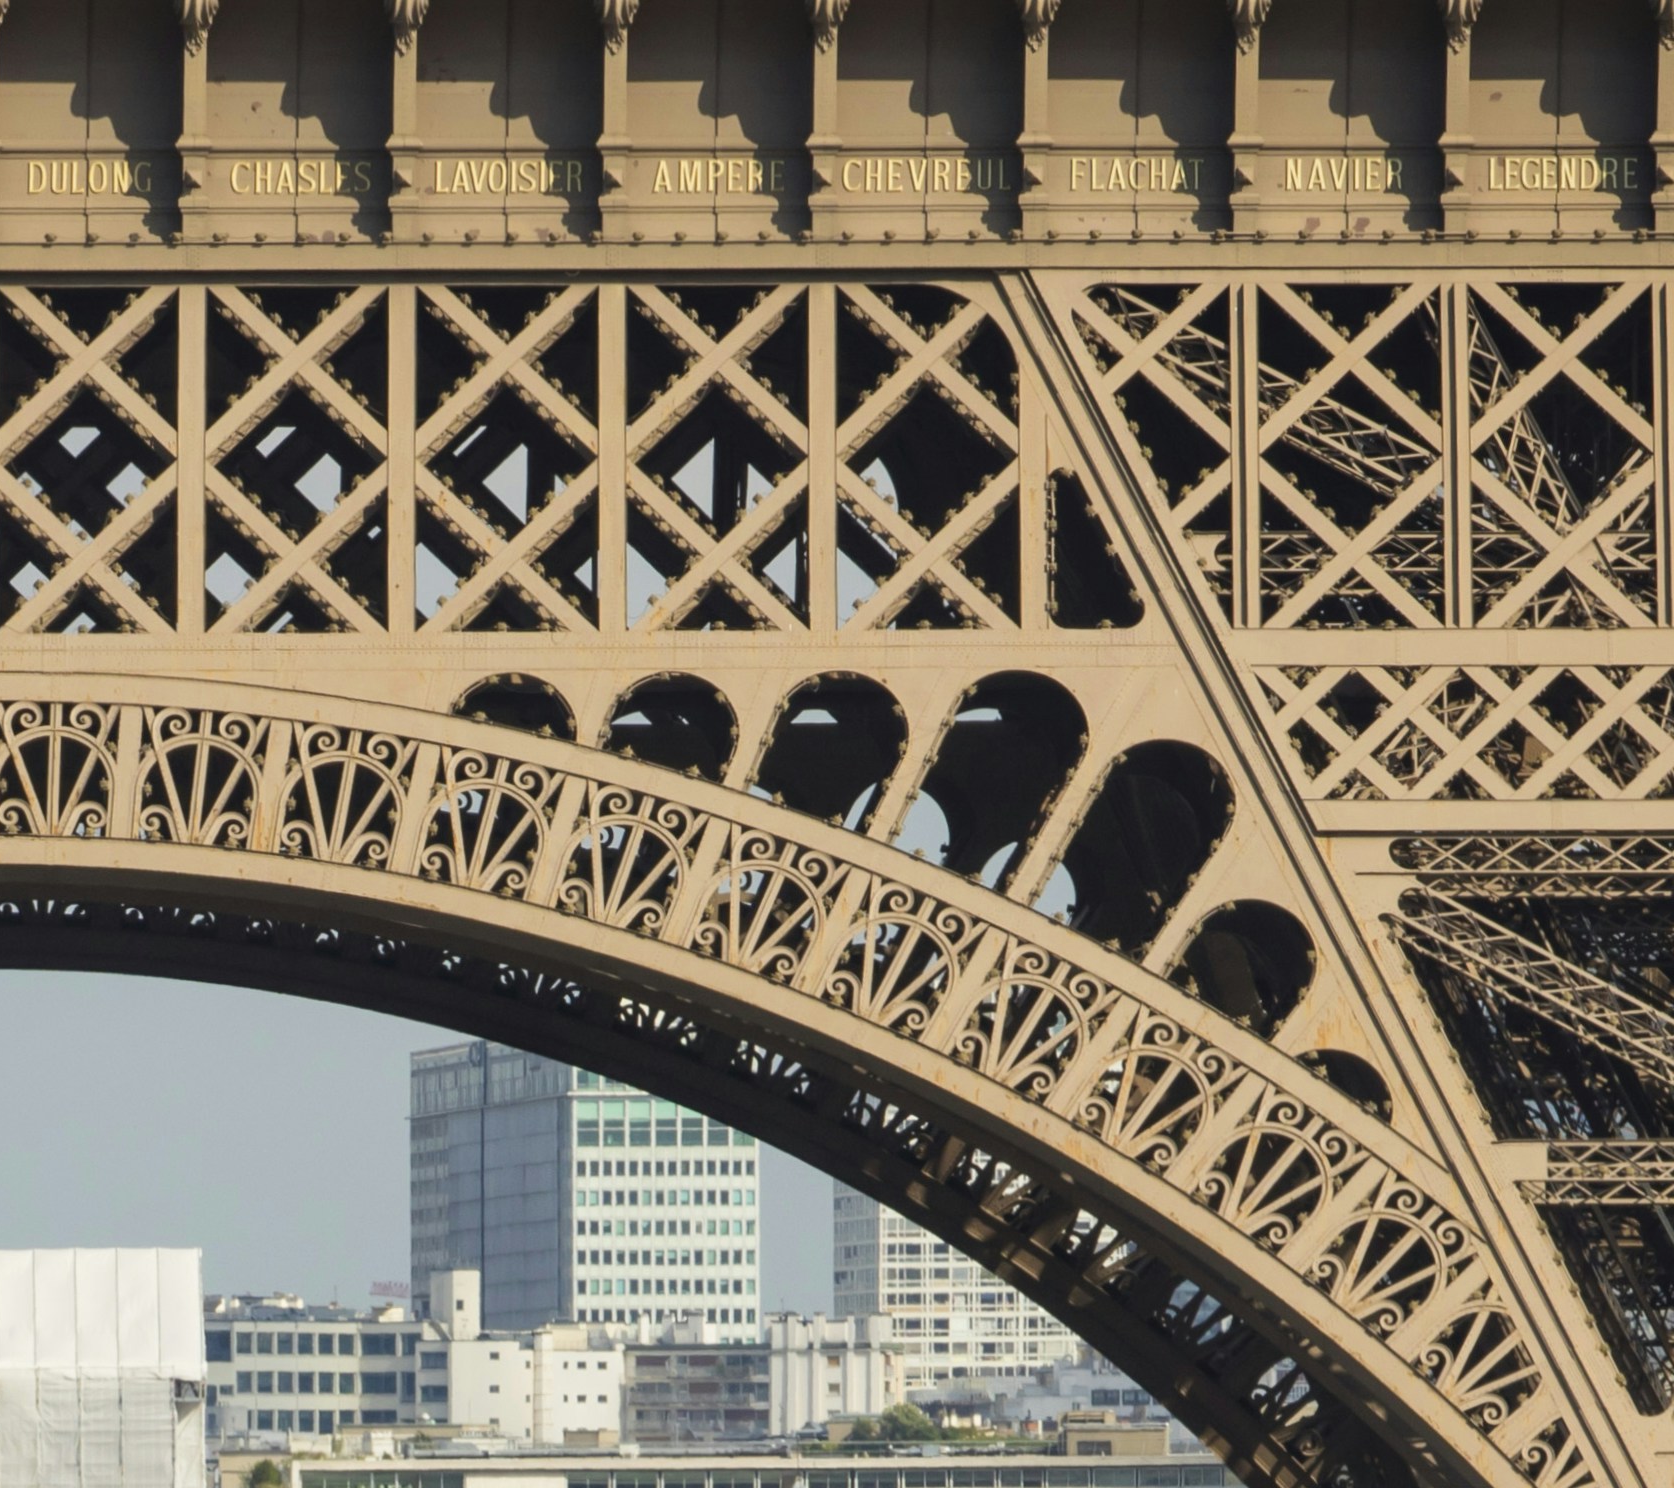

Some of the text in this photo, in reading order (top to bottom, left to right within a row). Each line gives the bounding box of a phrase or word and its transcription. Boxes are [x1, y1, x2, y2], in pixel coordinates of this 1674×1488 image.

[28, 161, 151, 194] DULONG
[230, 161, 371, 193] CHASLES
[434, 160, 582, 193] LAVOISIER
[653, 160, 784, 193] AMPERE
[842, 158, 1011, 192] CHEVREUL
[1070, 158, 1204, 192] FLACHAT
[1284, 157, 1402, 191] NAVIER
[1489, 157, 1638, 191] LEGENDRE
